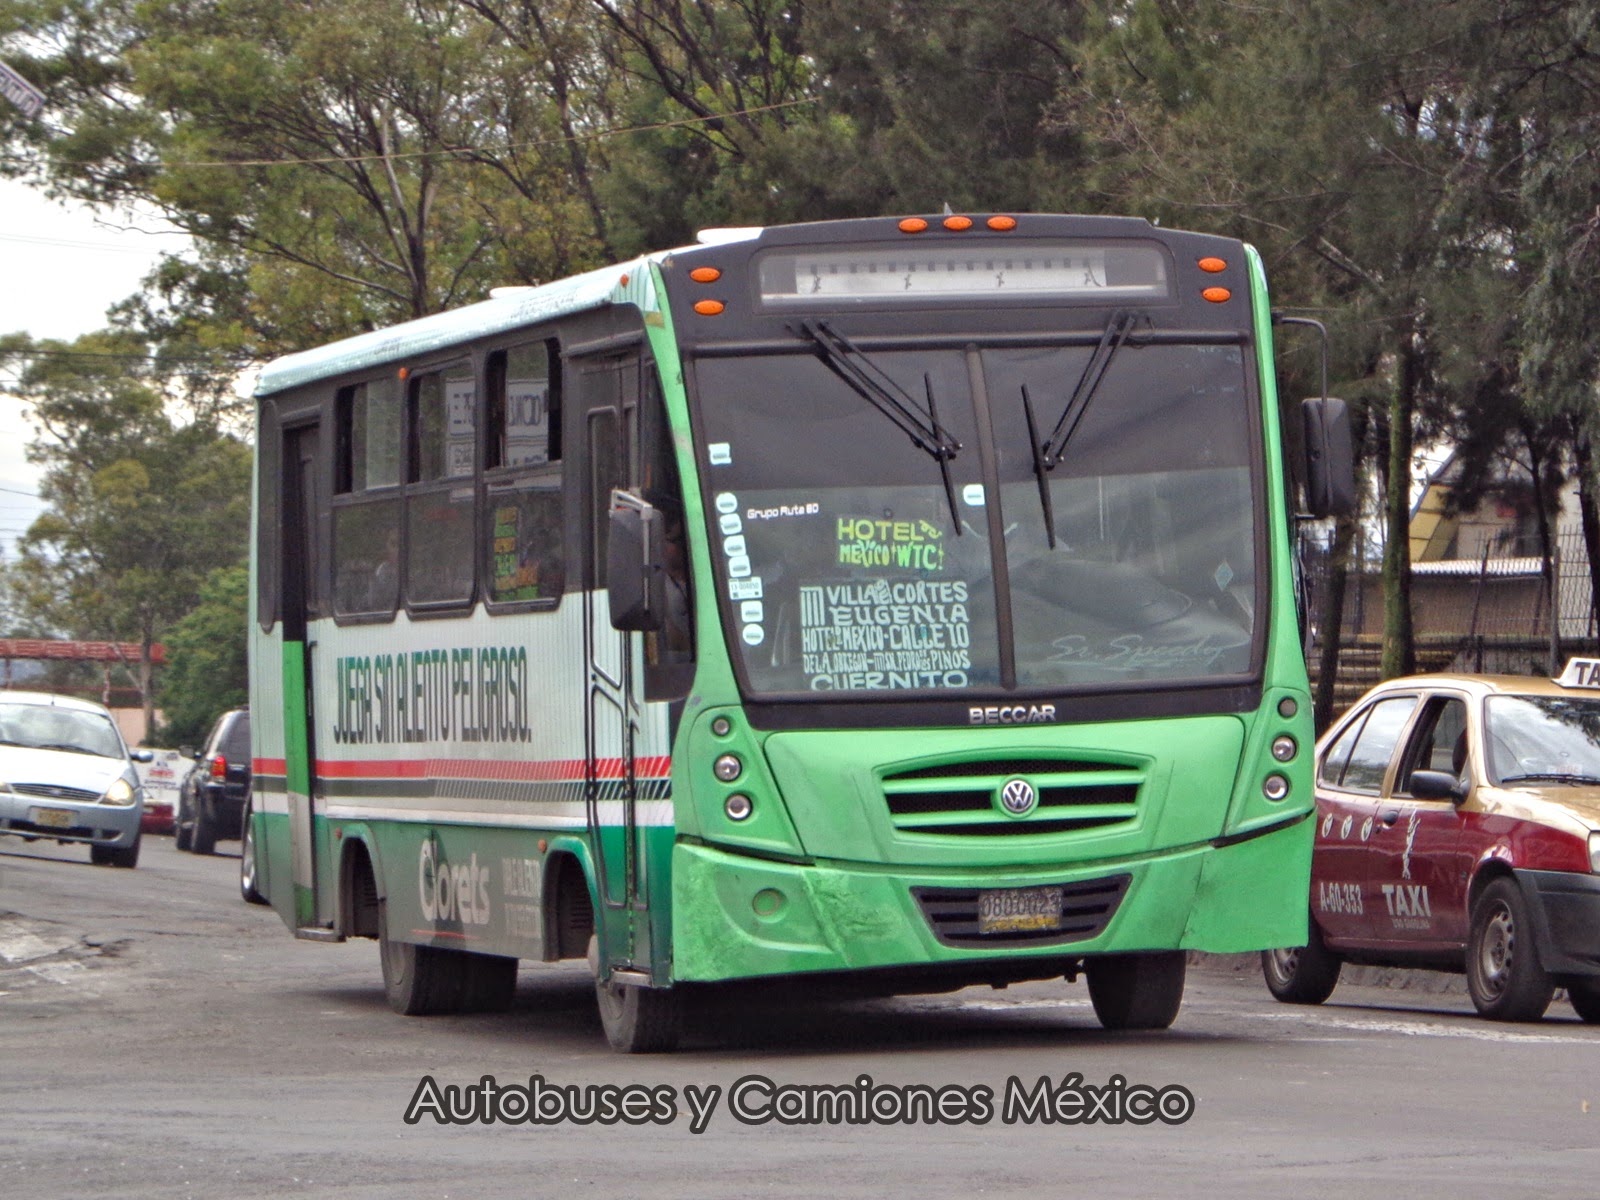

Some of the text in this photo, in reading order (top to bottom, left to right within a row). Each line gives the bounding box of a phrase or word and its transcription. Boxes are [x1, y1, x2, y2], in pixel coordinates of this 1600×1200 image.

[747, 508, 780, 520] Grupo
[780, 505, 805, 516] Ruta
[837, 518, 925, 541] HOTEL
[826, 584, 876, 605] VILLA
[893, 581, 968, 603] CORTES
[829, 604, 970, 626] EUGENIA
[843, 625, 885, 651] MEXICO
[889, 624, 945, 650] CALLE
[946, 623, 970, 649] 10
[931, 650, 971, 670] PINOS
[811, 670, 968, 690] CUERNITO
[333, 656, 372, 744] JUEGA
[374, 653, 395, 744] SIN
[396, 649, 449, 743] ALIENTO
[969, 704, 1056, 724] BECCAR
[1320, 882, 1432, 917] A-60-353 TAXI
